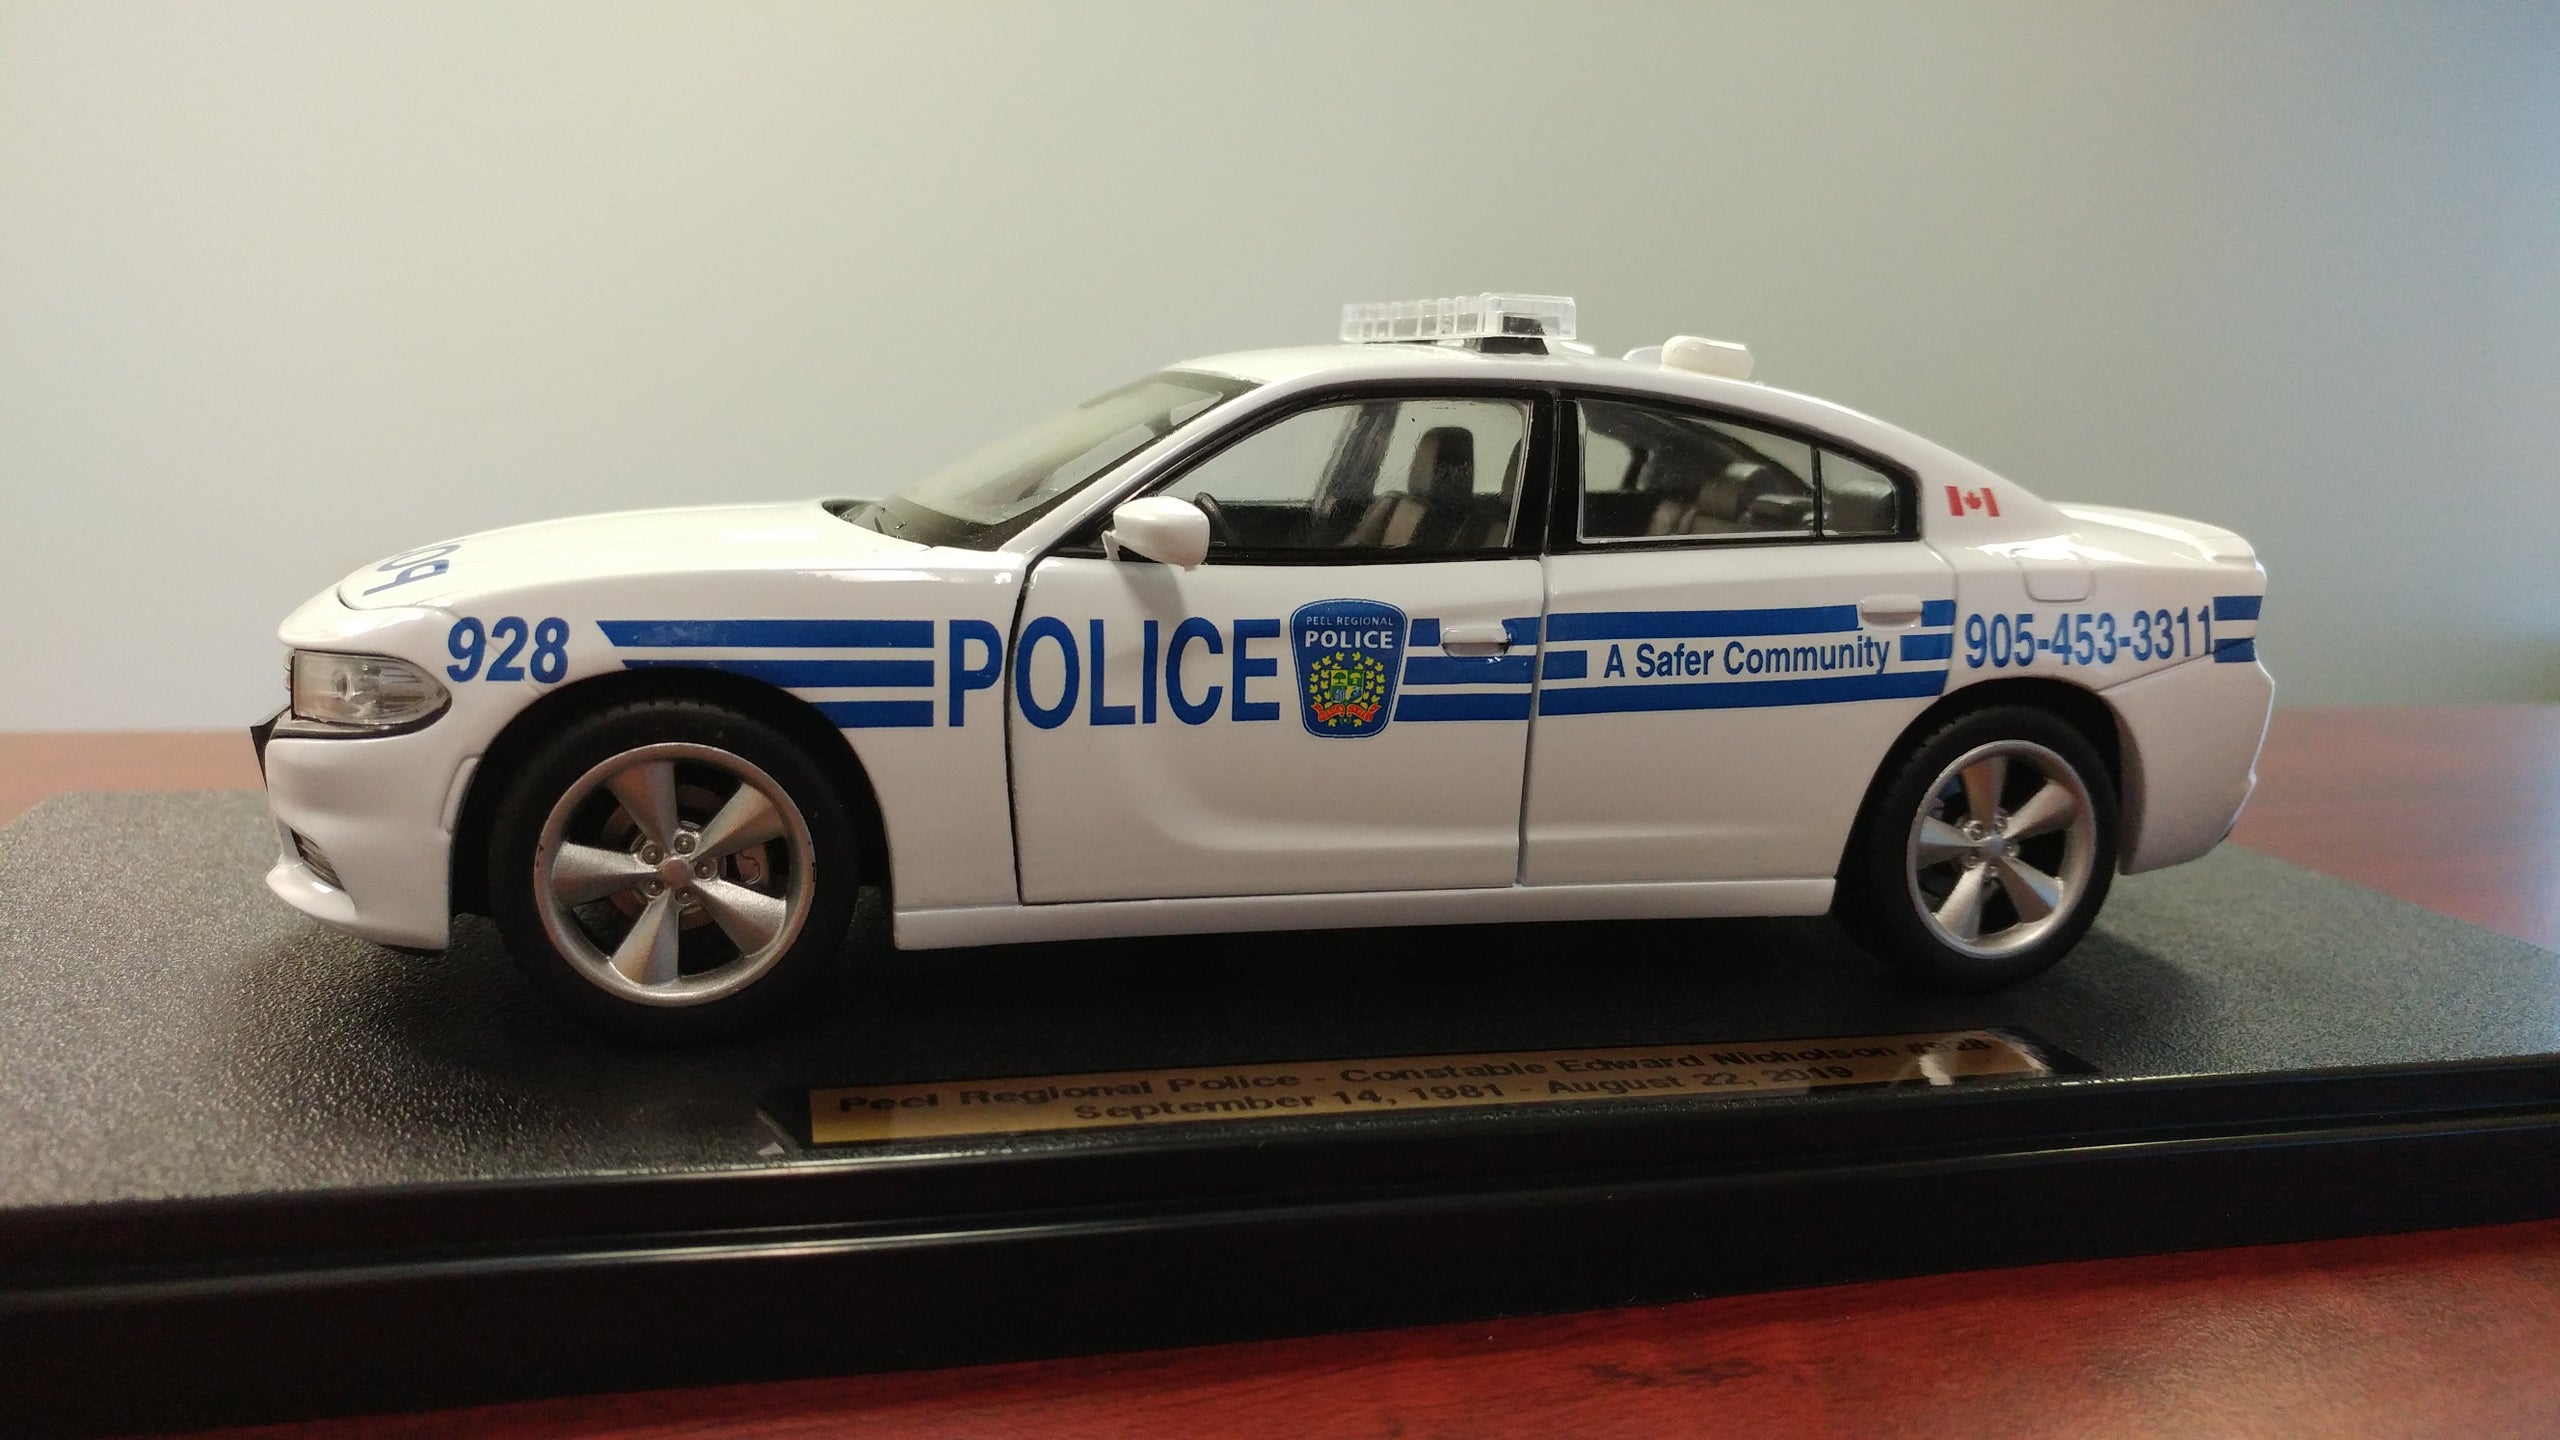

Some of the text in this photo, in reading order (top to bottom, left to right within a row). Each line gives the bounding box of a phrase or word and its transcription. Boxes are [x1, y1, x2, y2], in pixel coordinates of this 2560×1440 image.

[446, 616, 570, 684] 928
[1305, 630, 1394, 649] POLICE
[1306, 616, 1395, 626] PEEL REGIONAL
[1964, 605, 2211, 669] 905-453-3311
[948, 616, 1281, 730] POLICE
[1603, 634, 1890, 678] A Safer Community
[840, 1093, 939, 1113] Peel
[959, 1081, 1153, 1105] Regional
[1167, 1075, 1300, 1093] Police
[1340, 1061, 1547, 1083] Constable
[1556, 1053, 1705, 1073] Edward
[1710, 1045, 1898, 1067] Nicholson
[1074, 1095, 1317, 1121] September
[1332, 1089, 1397, 1105] 14,
[1409, 1083, 1505, 1100] 1981
[1548, 1075, 1685, 1095] August
[1692, 1071, 1758, 1087] 22,
[1761, 1066, 1854, 1082] 2019
